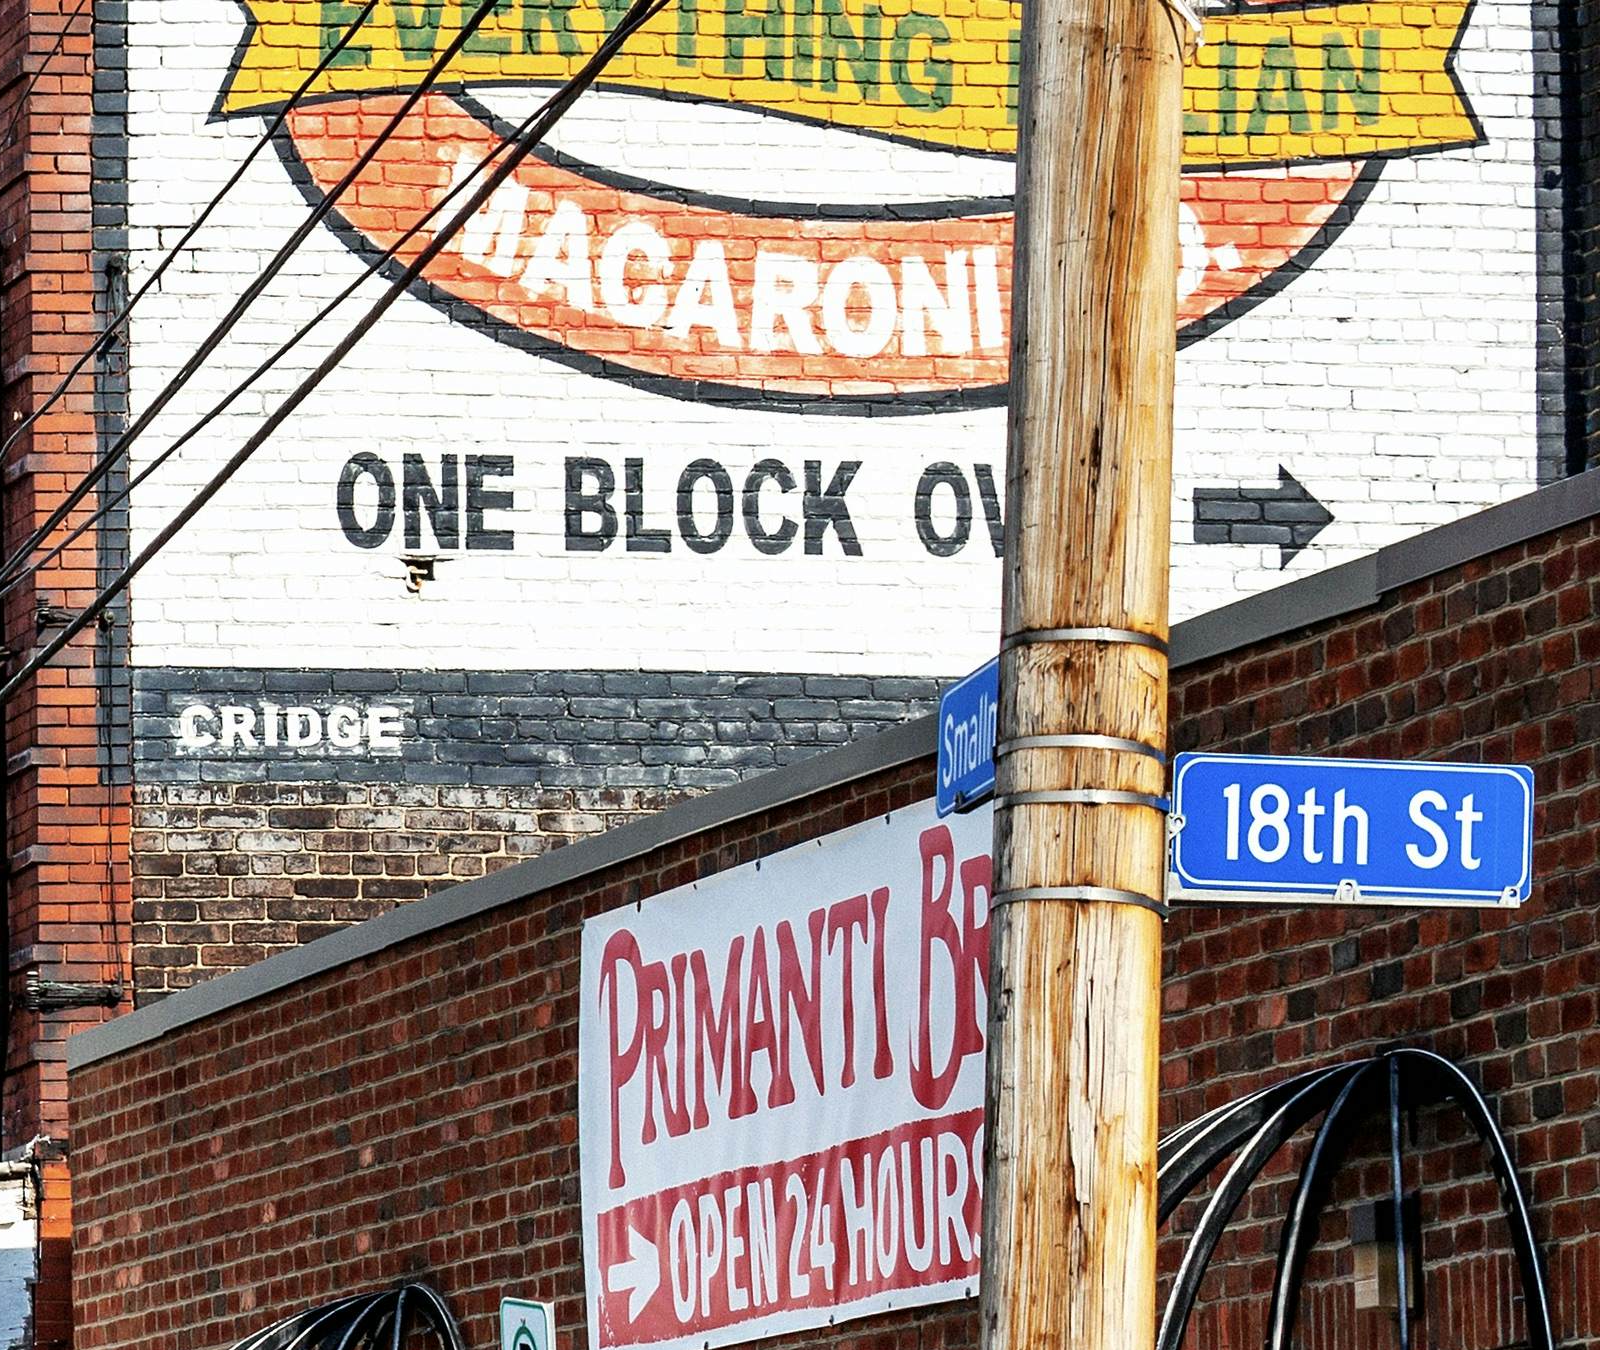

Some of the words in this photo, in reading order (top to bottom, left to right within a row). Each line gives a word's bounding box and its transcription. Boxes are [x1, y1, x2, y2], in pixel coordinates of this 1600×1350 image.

[436, 150, 1004, 358] MACARONI
[336, 451, 514, 550] ONE
[563, 456, 862, 556] BLOCK
[178, 703, 405, 750] CRIDGE
[1223, 783, 1368, 865] 18th
[1405, 789, 1483, 871] St
[598, 886, 894, 1190] PRIMANTI
[669, 1177, 776, 1324] OPEN
[785, 1167, 836, 1300] 24
